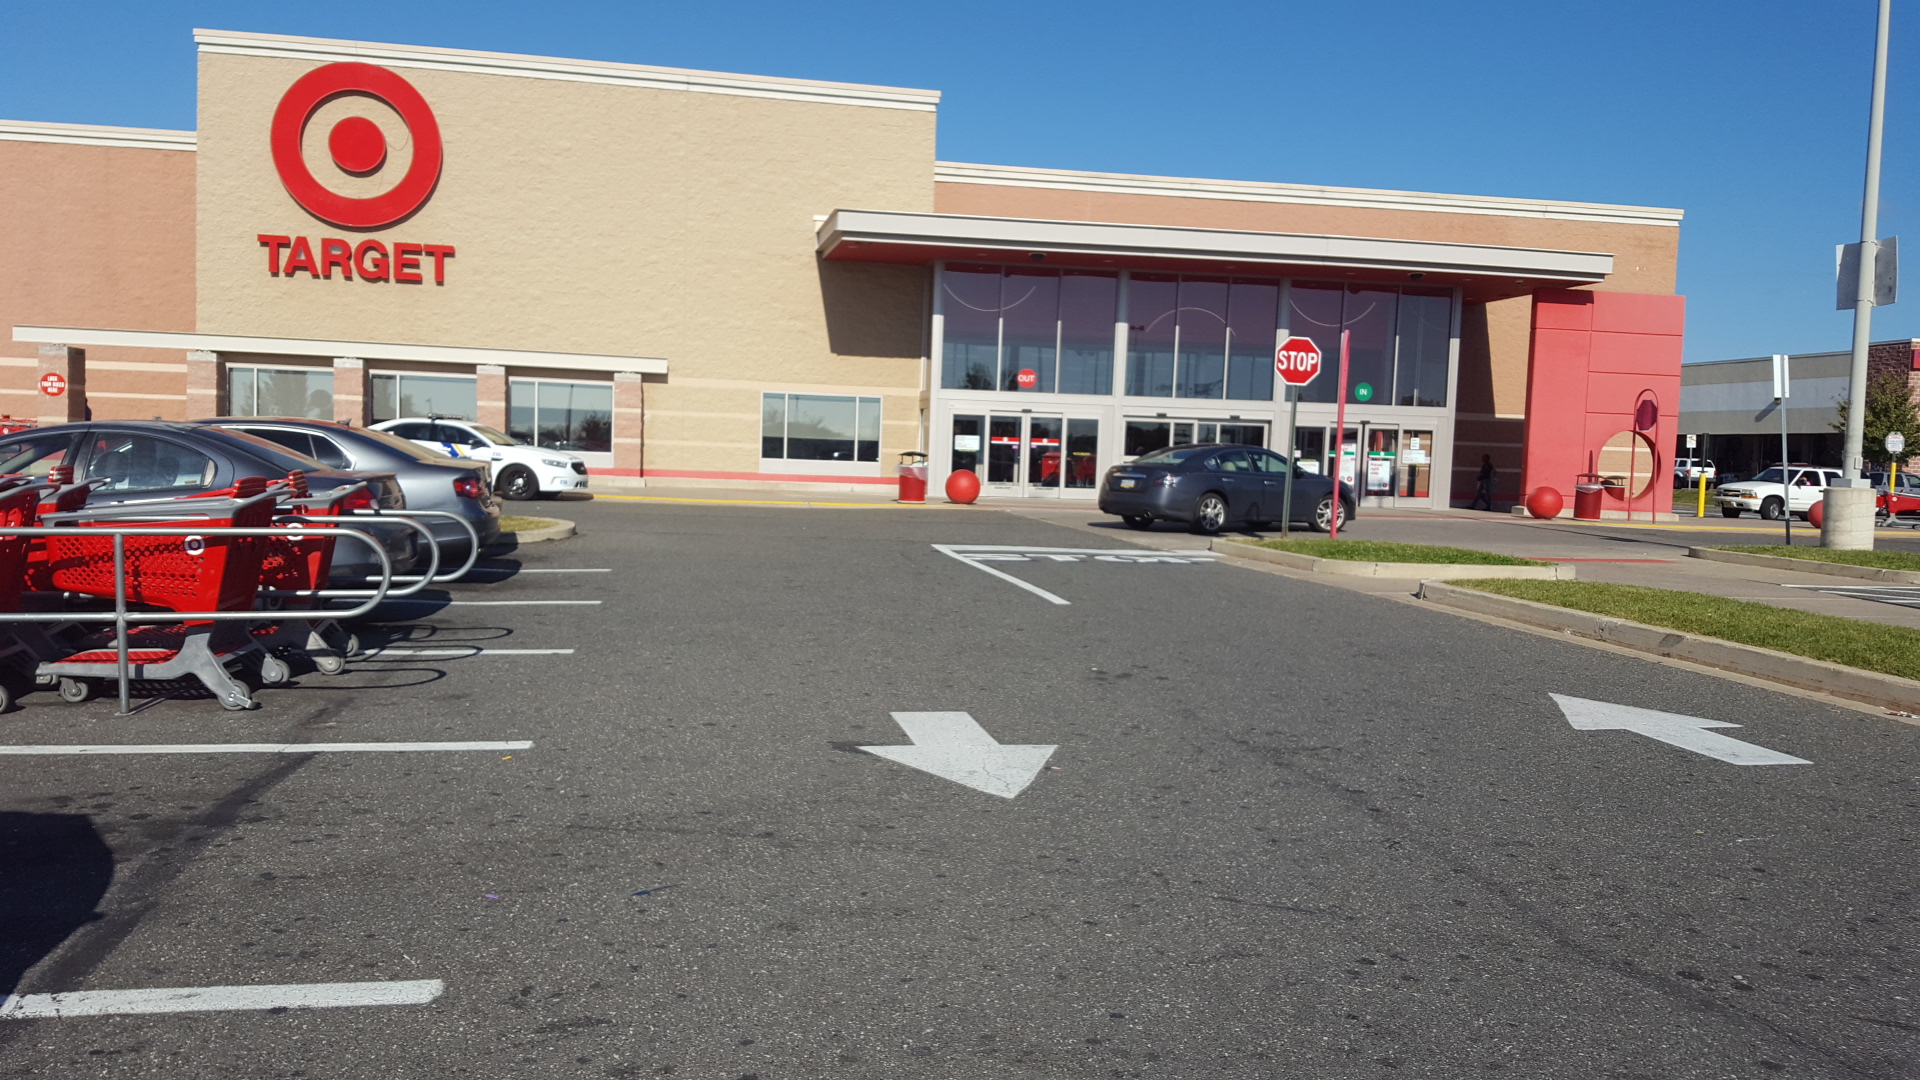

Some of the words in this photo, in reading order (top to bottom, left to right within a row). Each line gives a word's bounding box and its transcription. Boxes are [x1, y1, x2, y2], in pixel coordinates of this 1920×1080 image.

[257, 233, 455, 286] TARGET
[1277, 350, 1318, 372] STOP
[1017, 374, 1035, 383] OUT
[1359, 388, 1368, 396] IN
